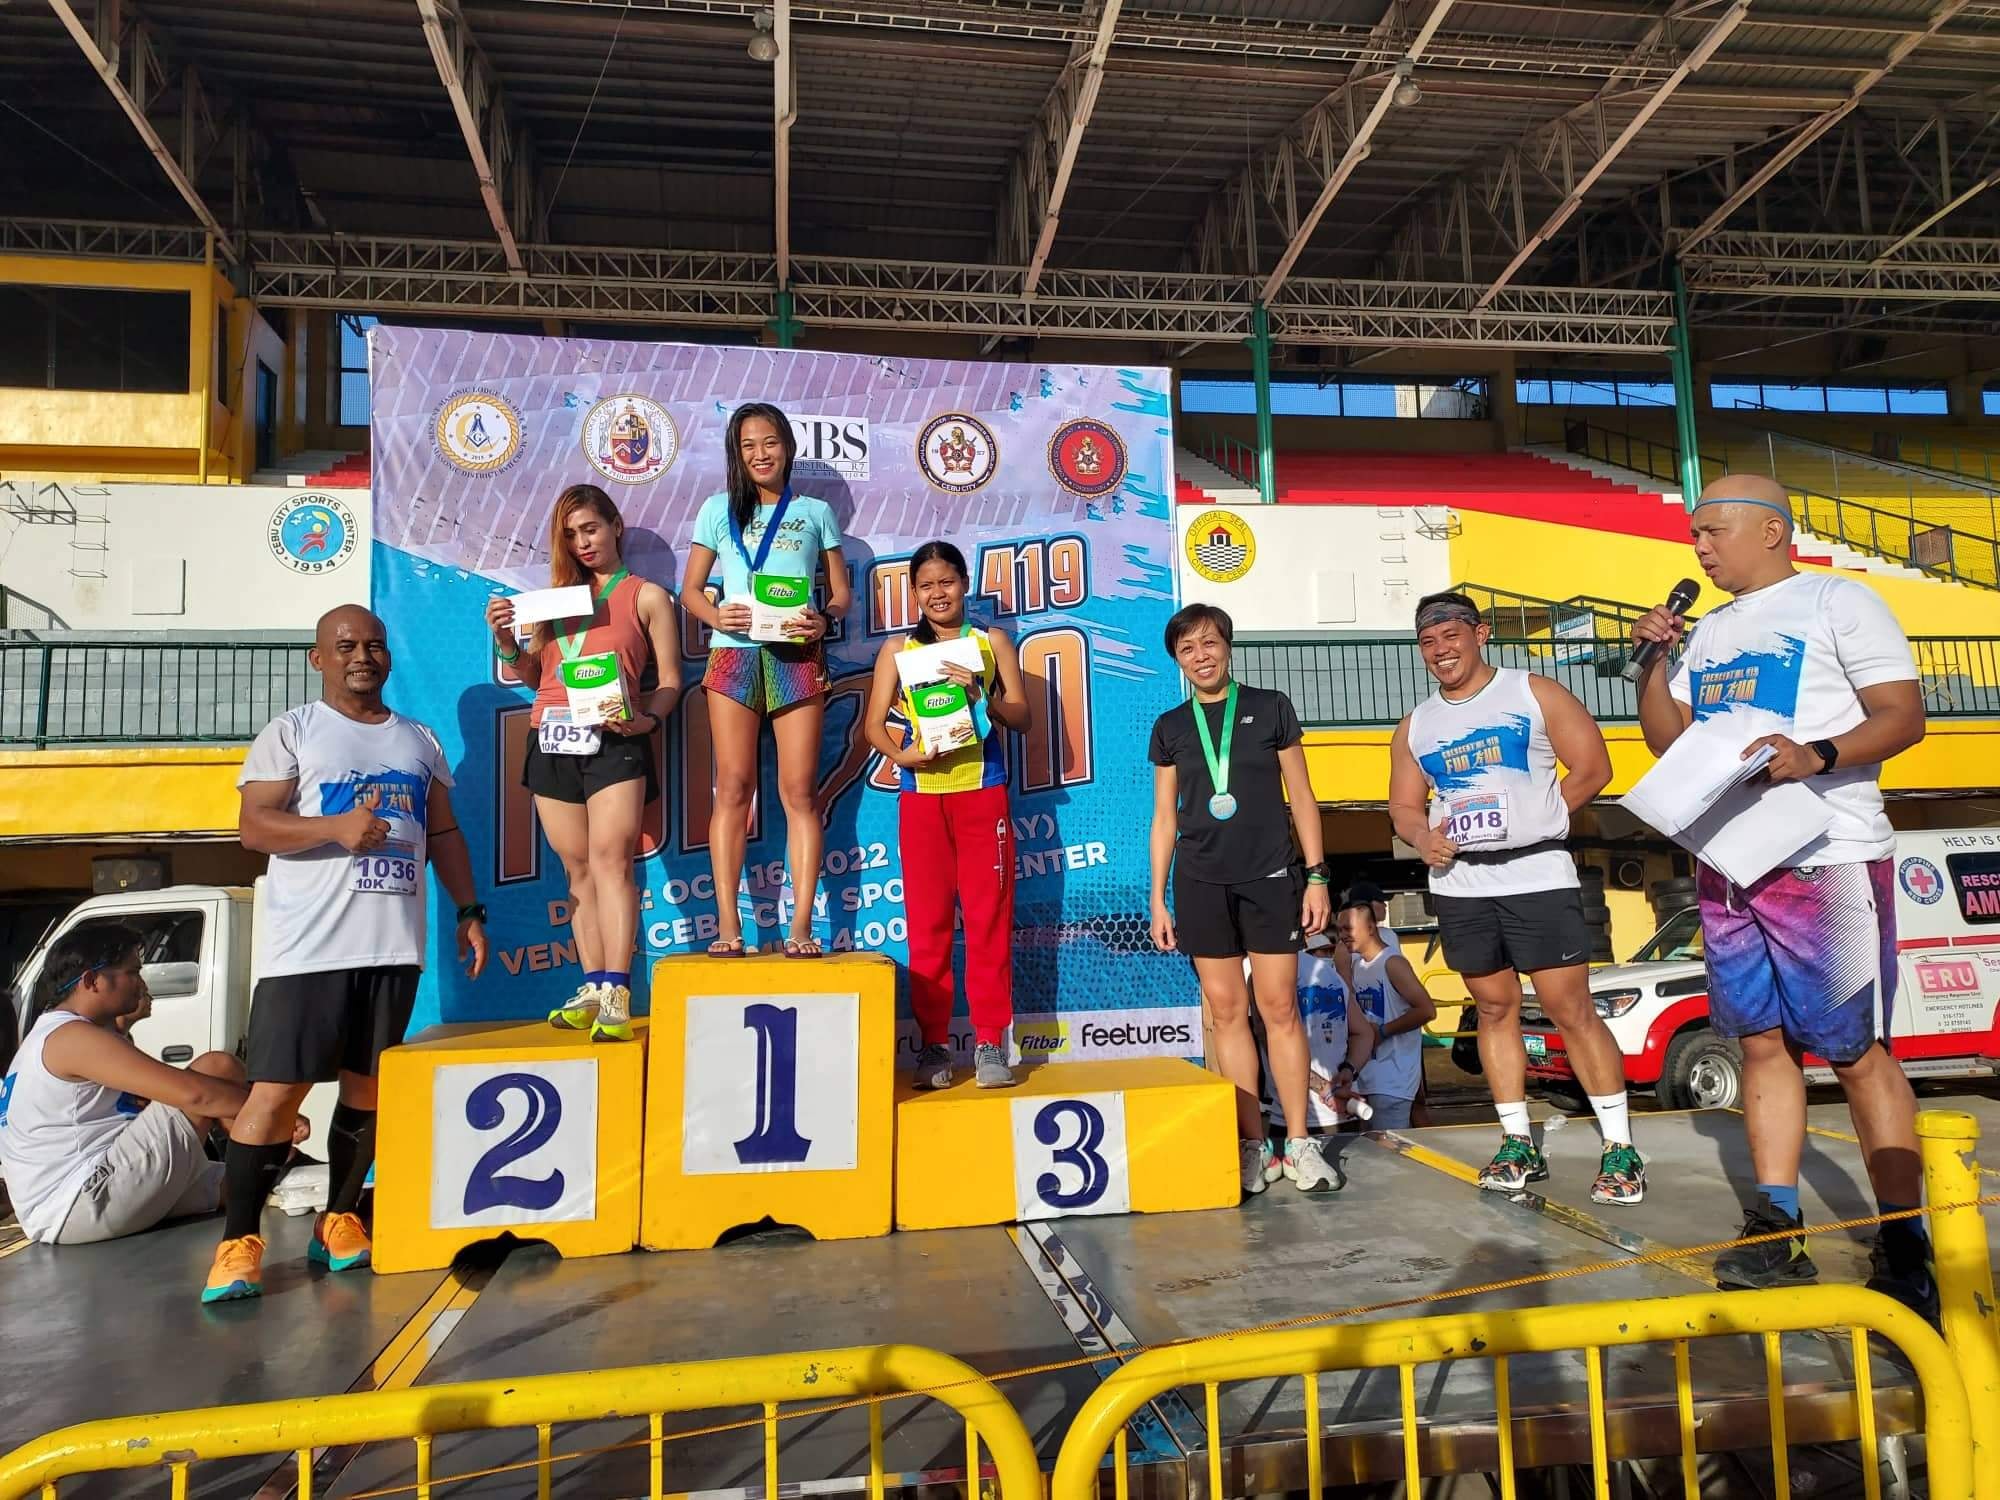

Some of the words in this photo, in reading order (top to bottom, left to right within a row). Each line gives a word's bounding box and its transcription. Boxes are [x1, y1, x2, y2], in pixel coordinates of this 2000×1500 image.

[941, 481, 961, 492] CEBU
[961, 482, 977, 493] CITY
[292, 495, 341, 511] SPORTS
[273, 504, 291, 526] CITY
[1189, 512, 1222, 537] OFFICIAL
[1230, 514, 1249, 535] SEAL
[270, 528, 285, 555] CEBU
[342, 512, 355, 553] CENTER
[293, 559, 336, 572] 1994
[1191, 558, 1210, 575] CITY
[1226, 564, 1249, 580] CEBU
[980, 537, 1087, 617] 419
[768, 586, 797, 598] Fitbar
[576, 667, 606, 679] Fitbar
[927, 694, 955, 708] Fitbar
[540, 724, 593, 743] 1057
[542, 742, 560, 752] 10K
[1447, 811, 1502, 835] 1018
[1942, 835, 1977, 848] HELP
[1980, 835, 1994, 846] IS
[356, 857, 416, 882] 1036
[819, 843, 889, 877] 022
[355, 878, 385, 889] 10K
[1961, 873, 2000, 888] RESC
[841, 878, 905, 912] SPO
[1966, 889, 2000, 916] AM
[1920, 966, 1975, 989] ERU
[1020, 1034, 1067, 1051] Fitbar
[1081, 1021, 1195, 1048] feetures.
[733, 1003, 812, 1164] 1
[463, 1072, 565, 1216] 2
[1034, 1099, 1110, 1209] 3
